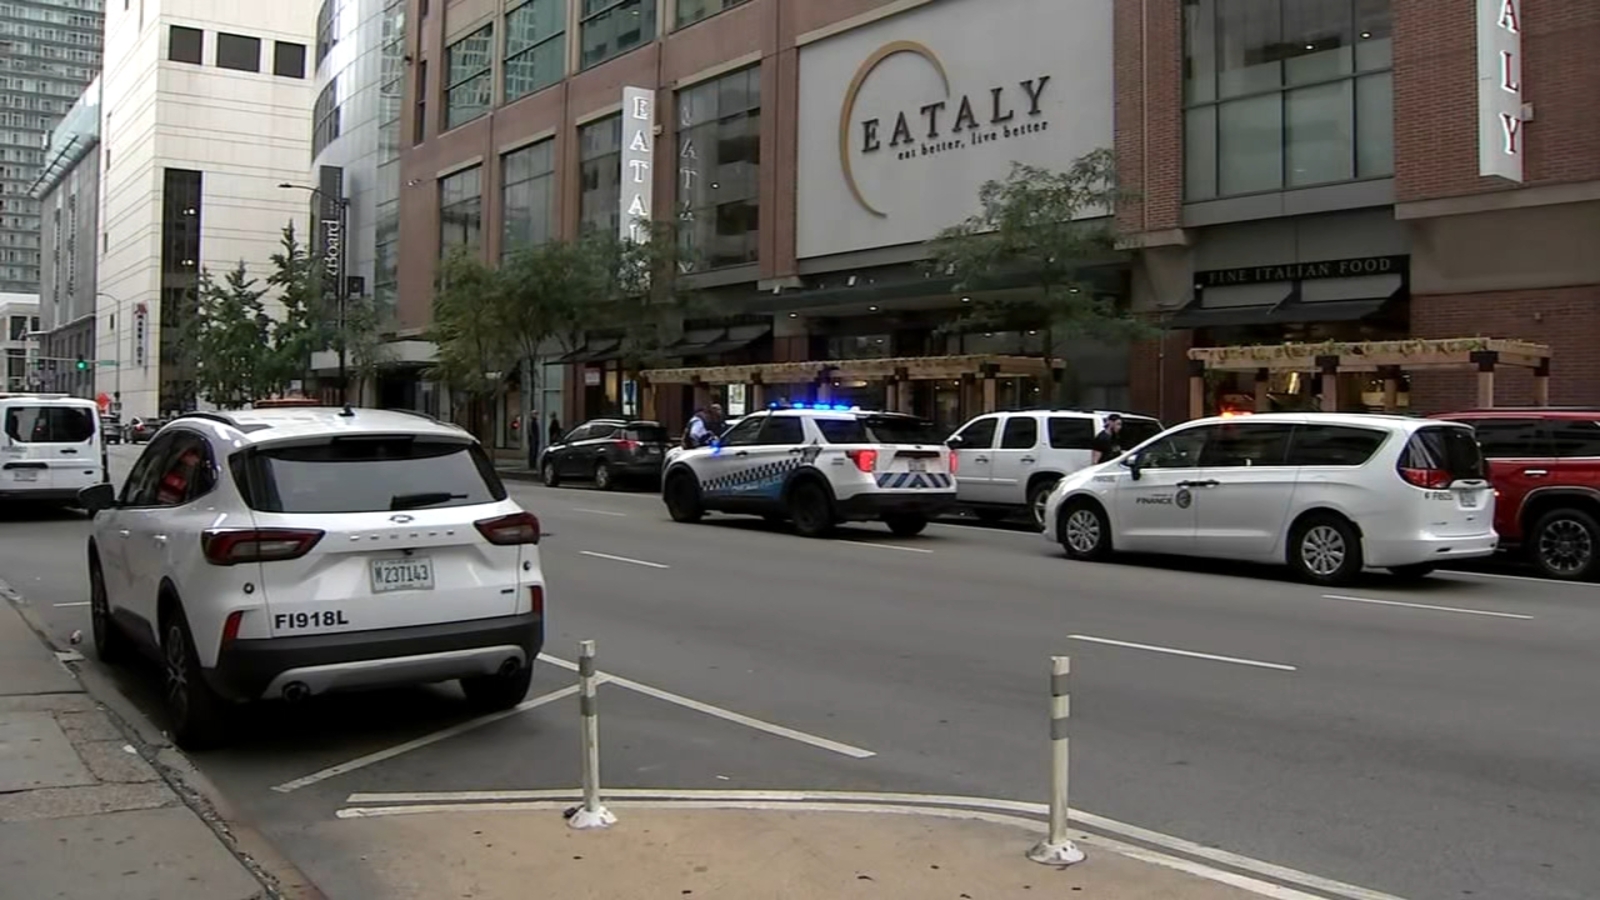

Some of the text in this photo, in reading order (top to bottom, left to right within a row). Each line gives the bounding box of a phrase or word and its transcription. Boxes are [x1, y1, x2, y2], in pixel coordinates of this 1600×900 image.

[861, 75, 1051, 154] EATALY
[898, 119, 1049, 161] eat better, live better
[628, 96, 650, 277] EATAL
[1208, 257, 1392, 285] FINE ITALIAN FOOD
[274, 610, 350, 630] FI918L
